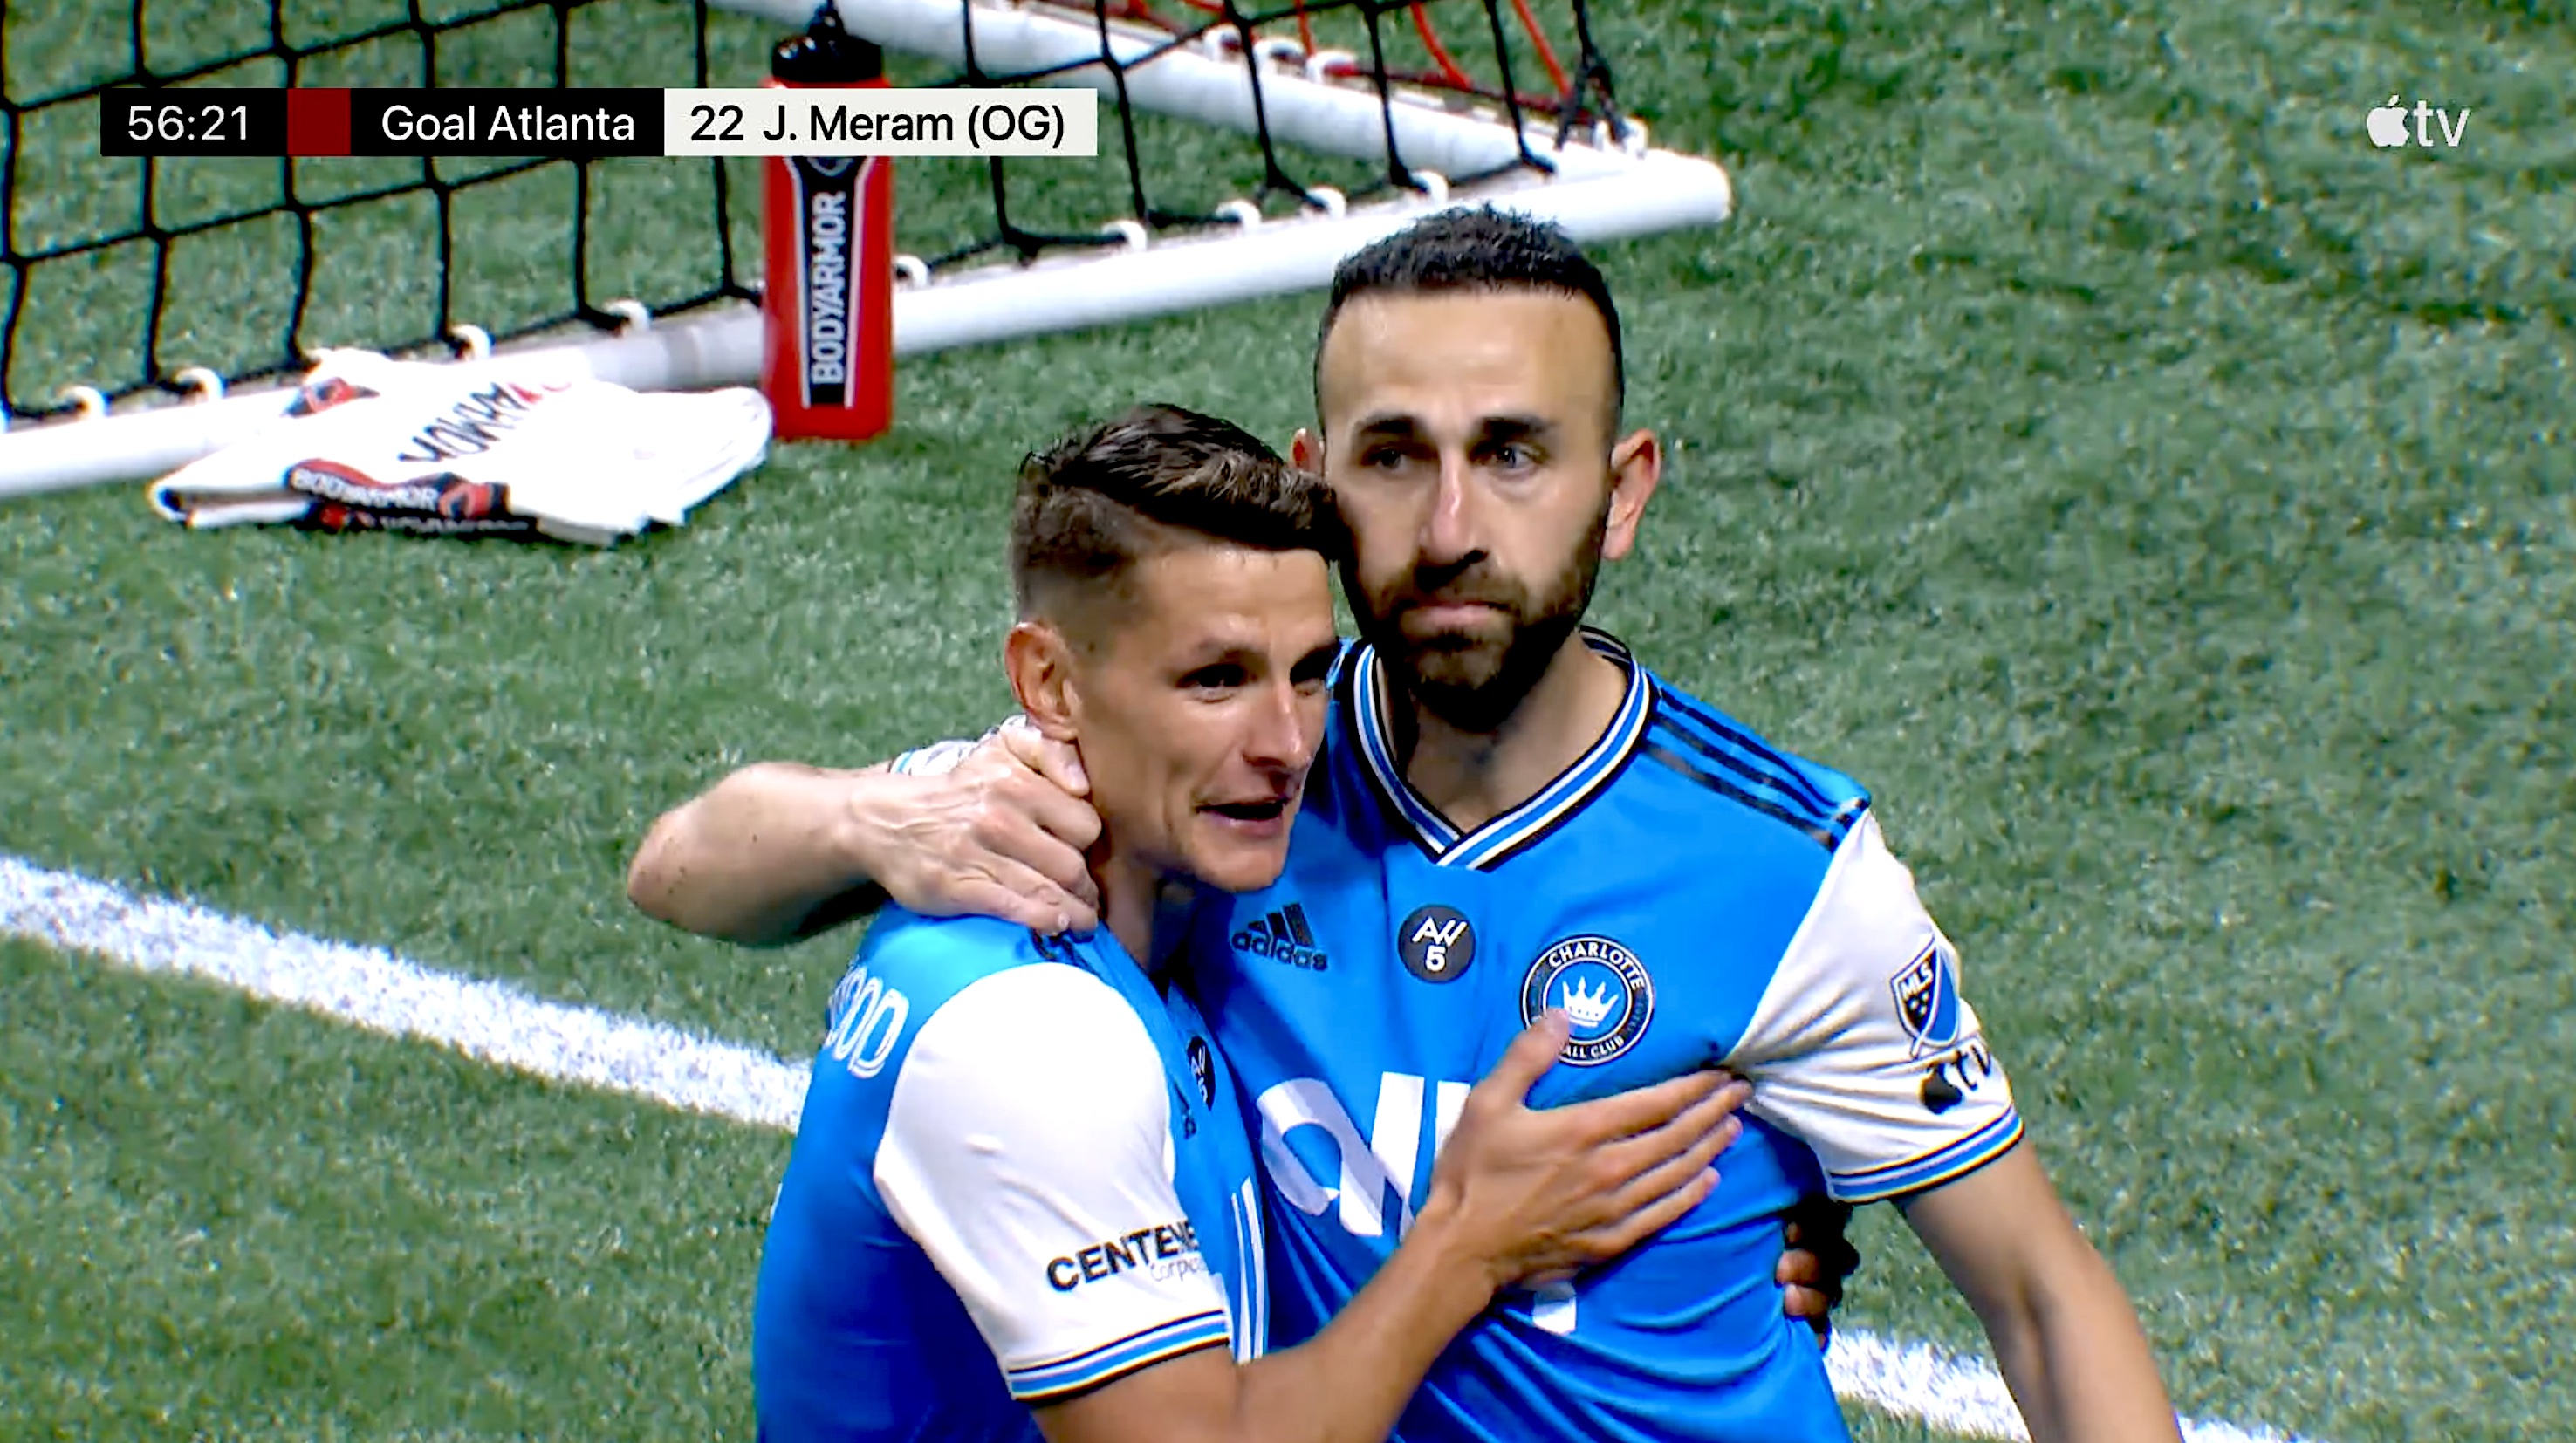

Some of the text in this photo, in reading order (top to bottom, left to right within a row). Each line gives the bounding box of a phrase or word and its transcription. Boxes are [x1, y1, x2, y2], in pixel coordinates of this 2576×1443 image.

[811, 190, 847, 385] BODYARMOR
[1230, 930, 1328, 972] adidas
[1425, 944, 1446, 972] 5
[1548, 941, 1646, 991] CHARLOTTE
[1900, 961, 1934, 1001] MLS
[1590, 1036, 1625, 1058] CLUB
